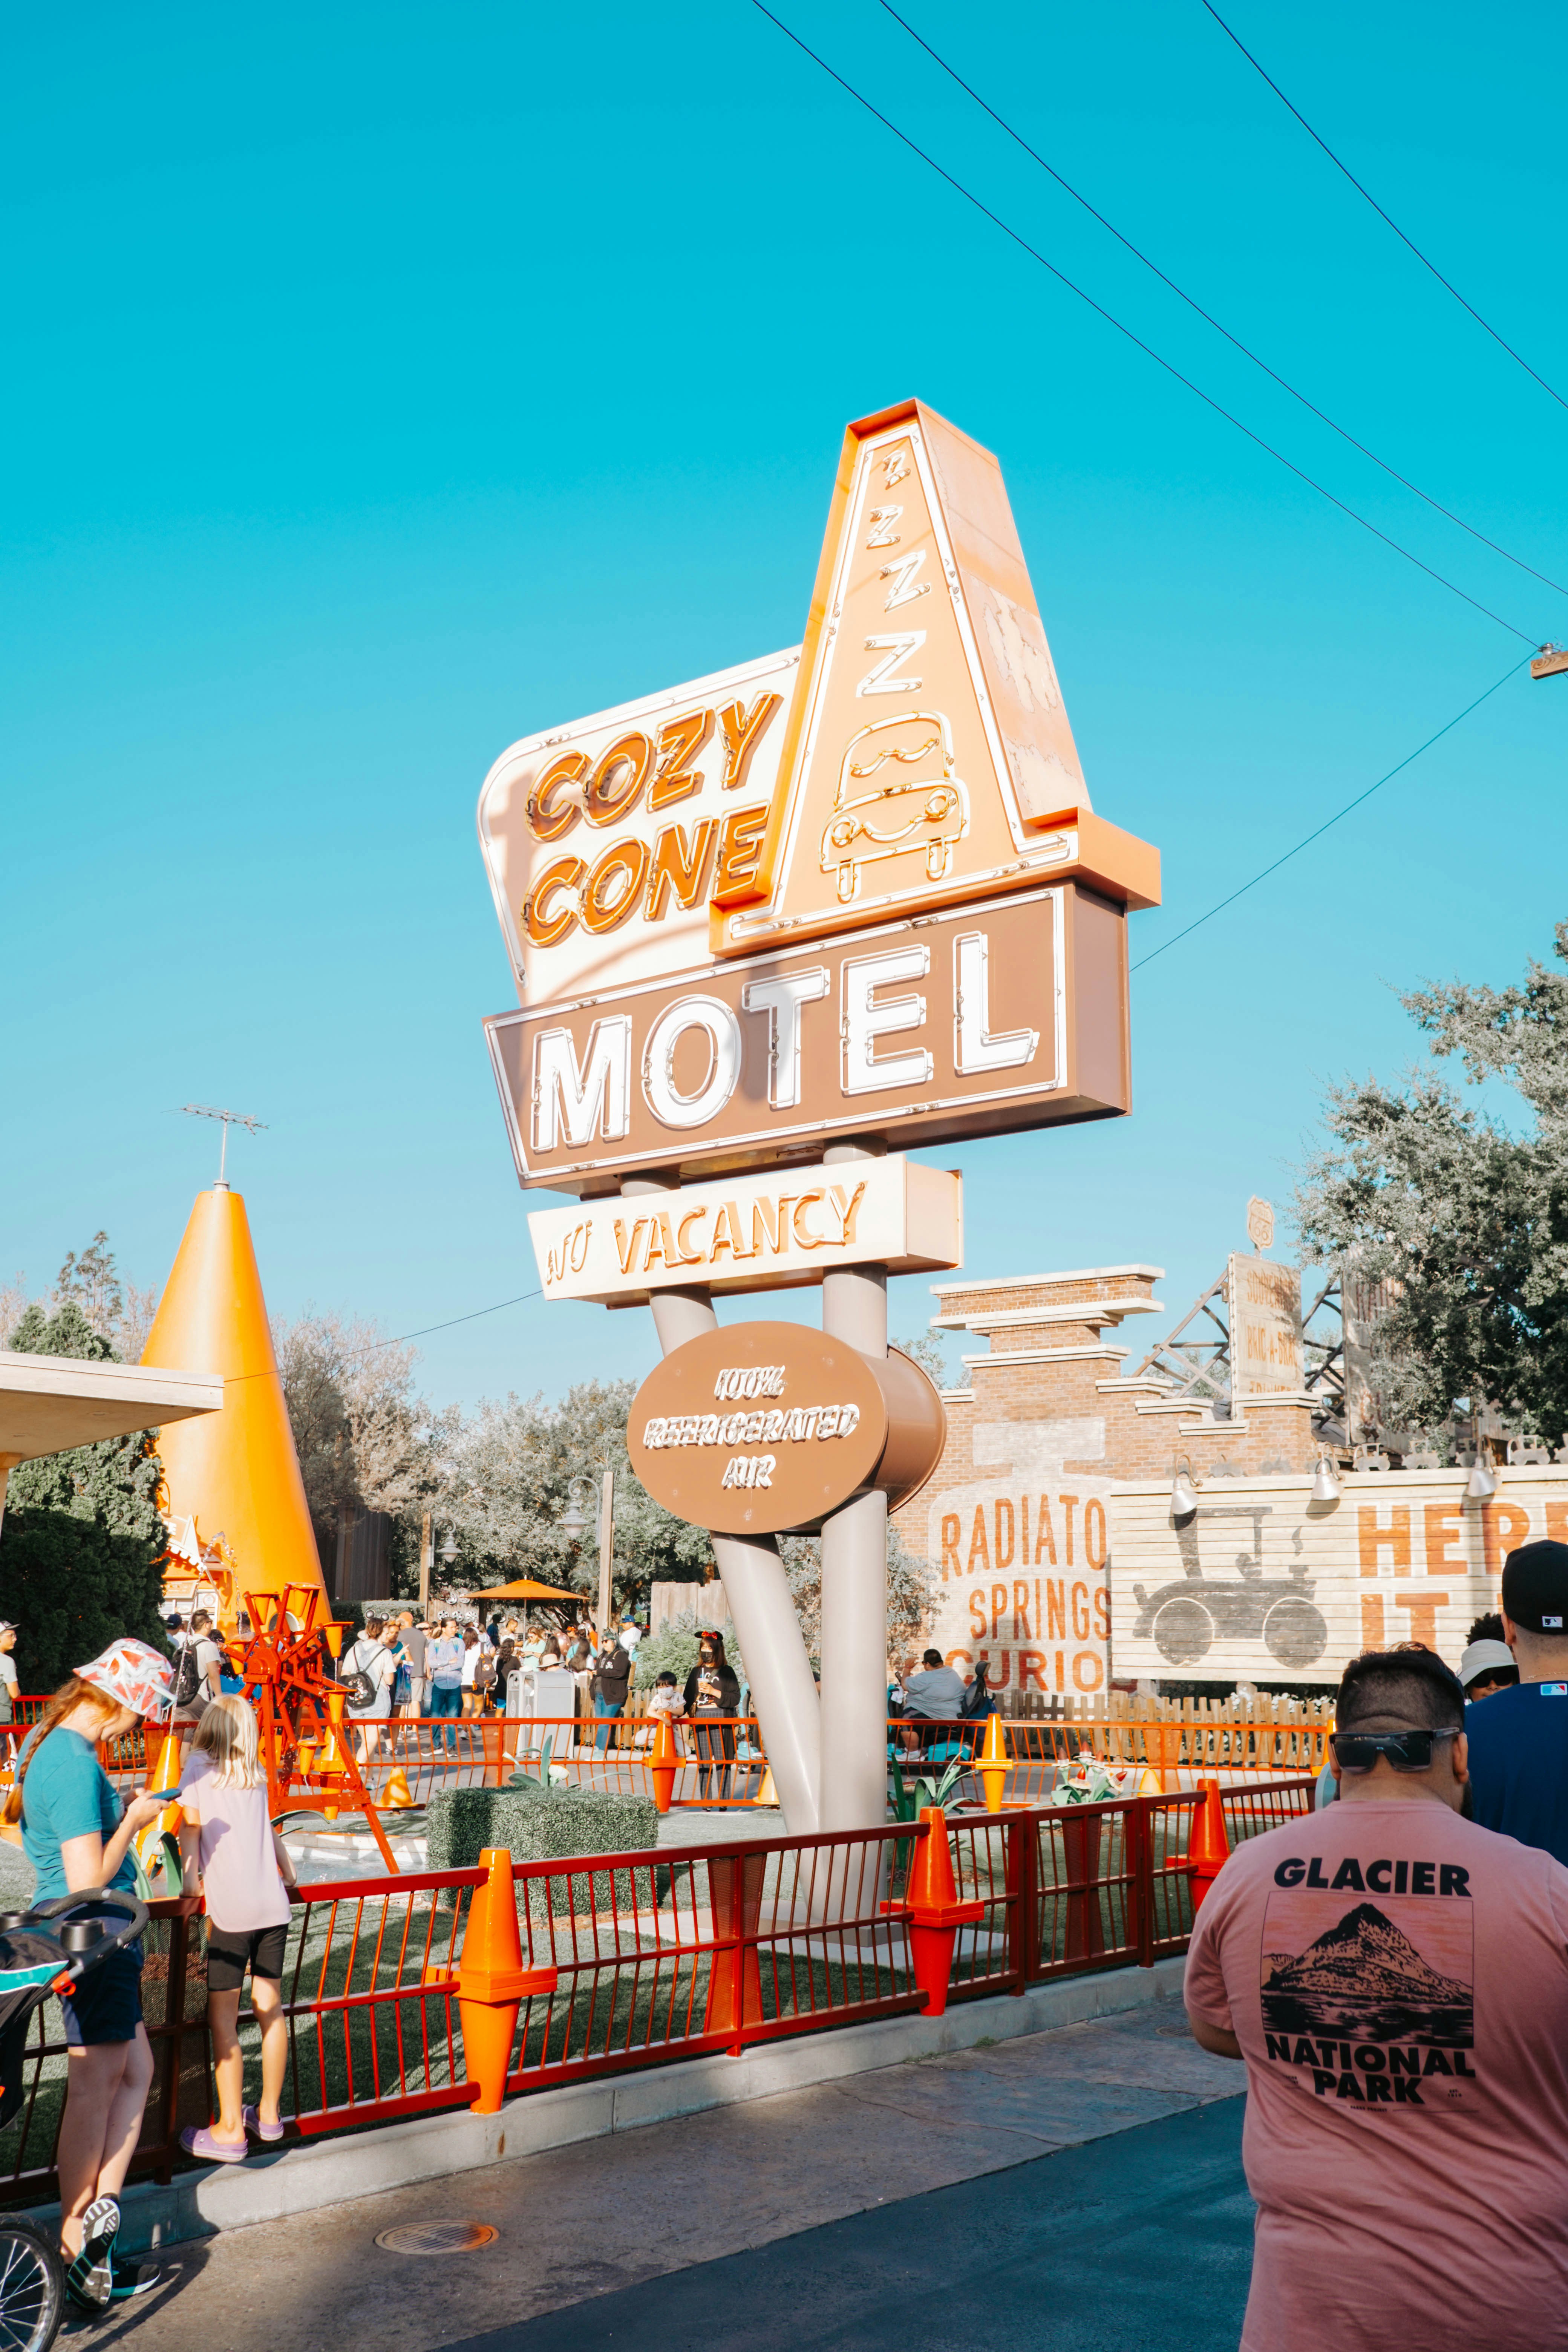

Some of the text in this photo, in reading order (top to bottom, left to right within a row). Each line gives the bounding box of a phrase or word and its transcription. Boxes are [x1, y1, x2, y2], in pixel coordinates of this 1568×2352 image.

[525, 690, 783, 842] COZY
[521, 799, 774, 946] CONE
[531, 932, 1040, 1152] MOTEL
[544, 1180, 869, 1283] NO VACANCY
[1255, 1220, 1269, 1241] 66
[714, 1365, 787, 1401] 100%
[643, 1403, 860, 1449] REFRIGERATED
[721, 1454, 776, 1490] AIR
[969, 1579, 1112, 1641] SPRINGS
[1361, 1592, 1449, 1653] IT
[1274, 1857, 1472, 1897] GLACIER
[1265, 2034, 1476, 2077] NATIONAL
[1312, 2068, 1425, 2104] PARK
